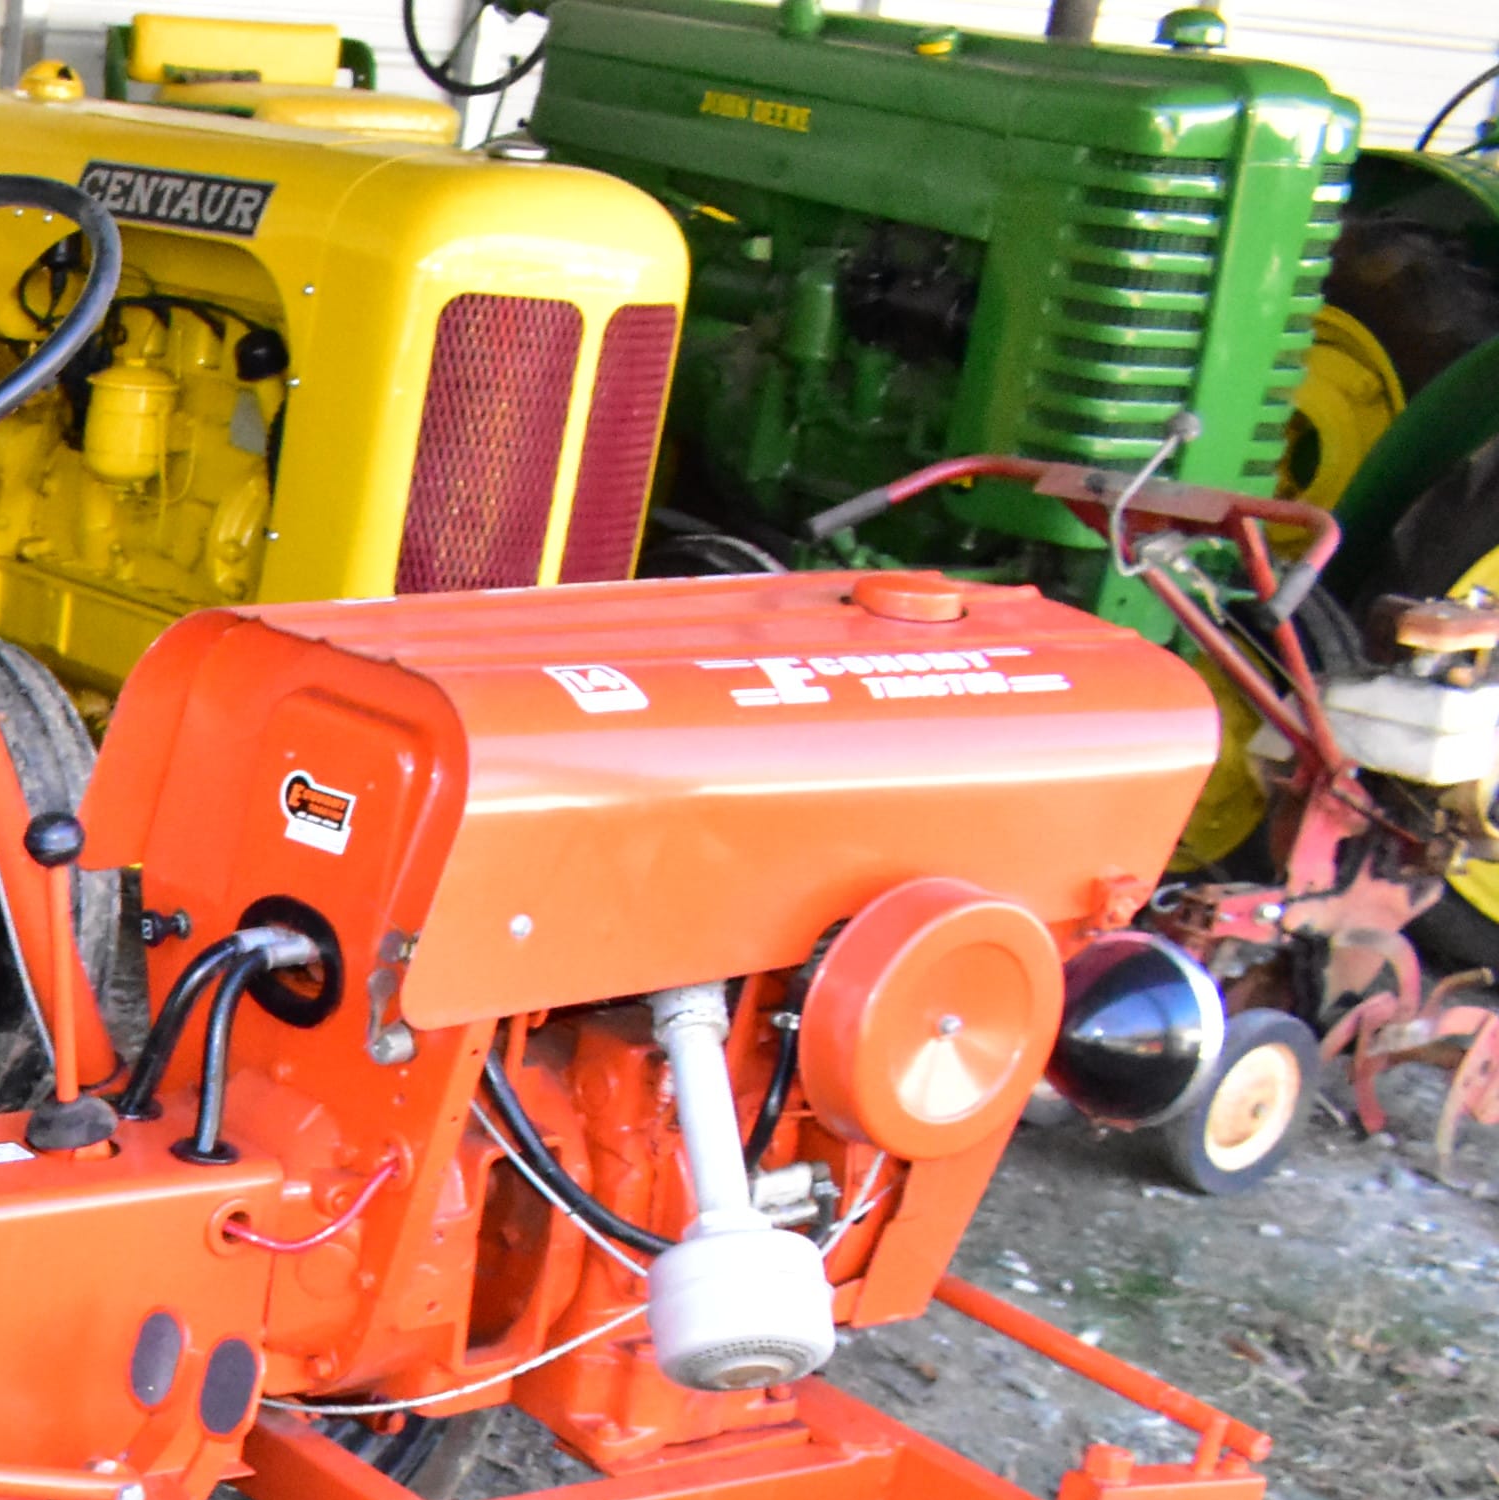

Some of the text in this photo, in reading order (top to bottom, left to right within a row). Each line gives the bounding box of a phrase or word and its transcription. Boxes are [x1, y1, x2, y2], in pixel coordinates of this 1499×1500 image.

[81, 168, 264, 229] CENTAUR
[559, 667, 622, 692] 14
[753, 649, 992, 705] ECONOMY
